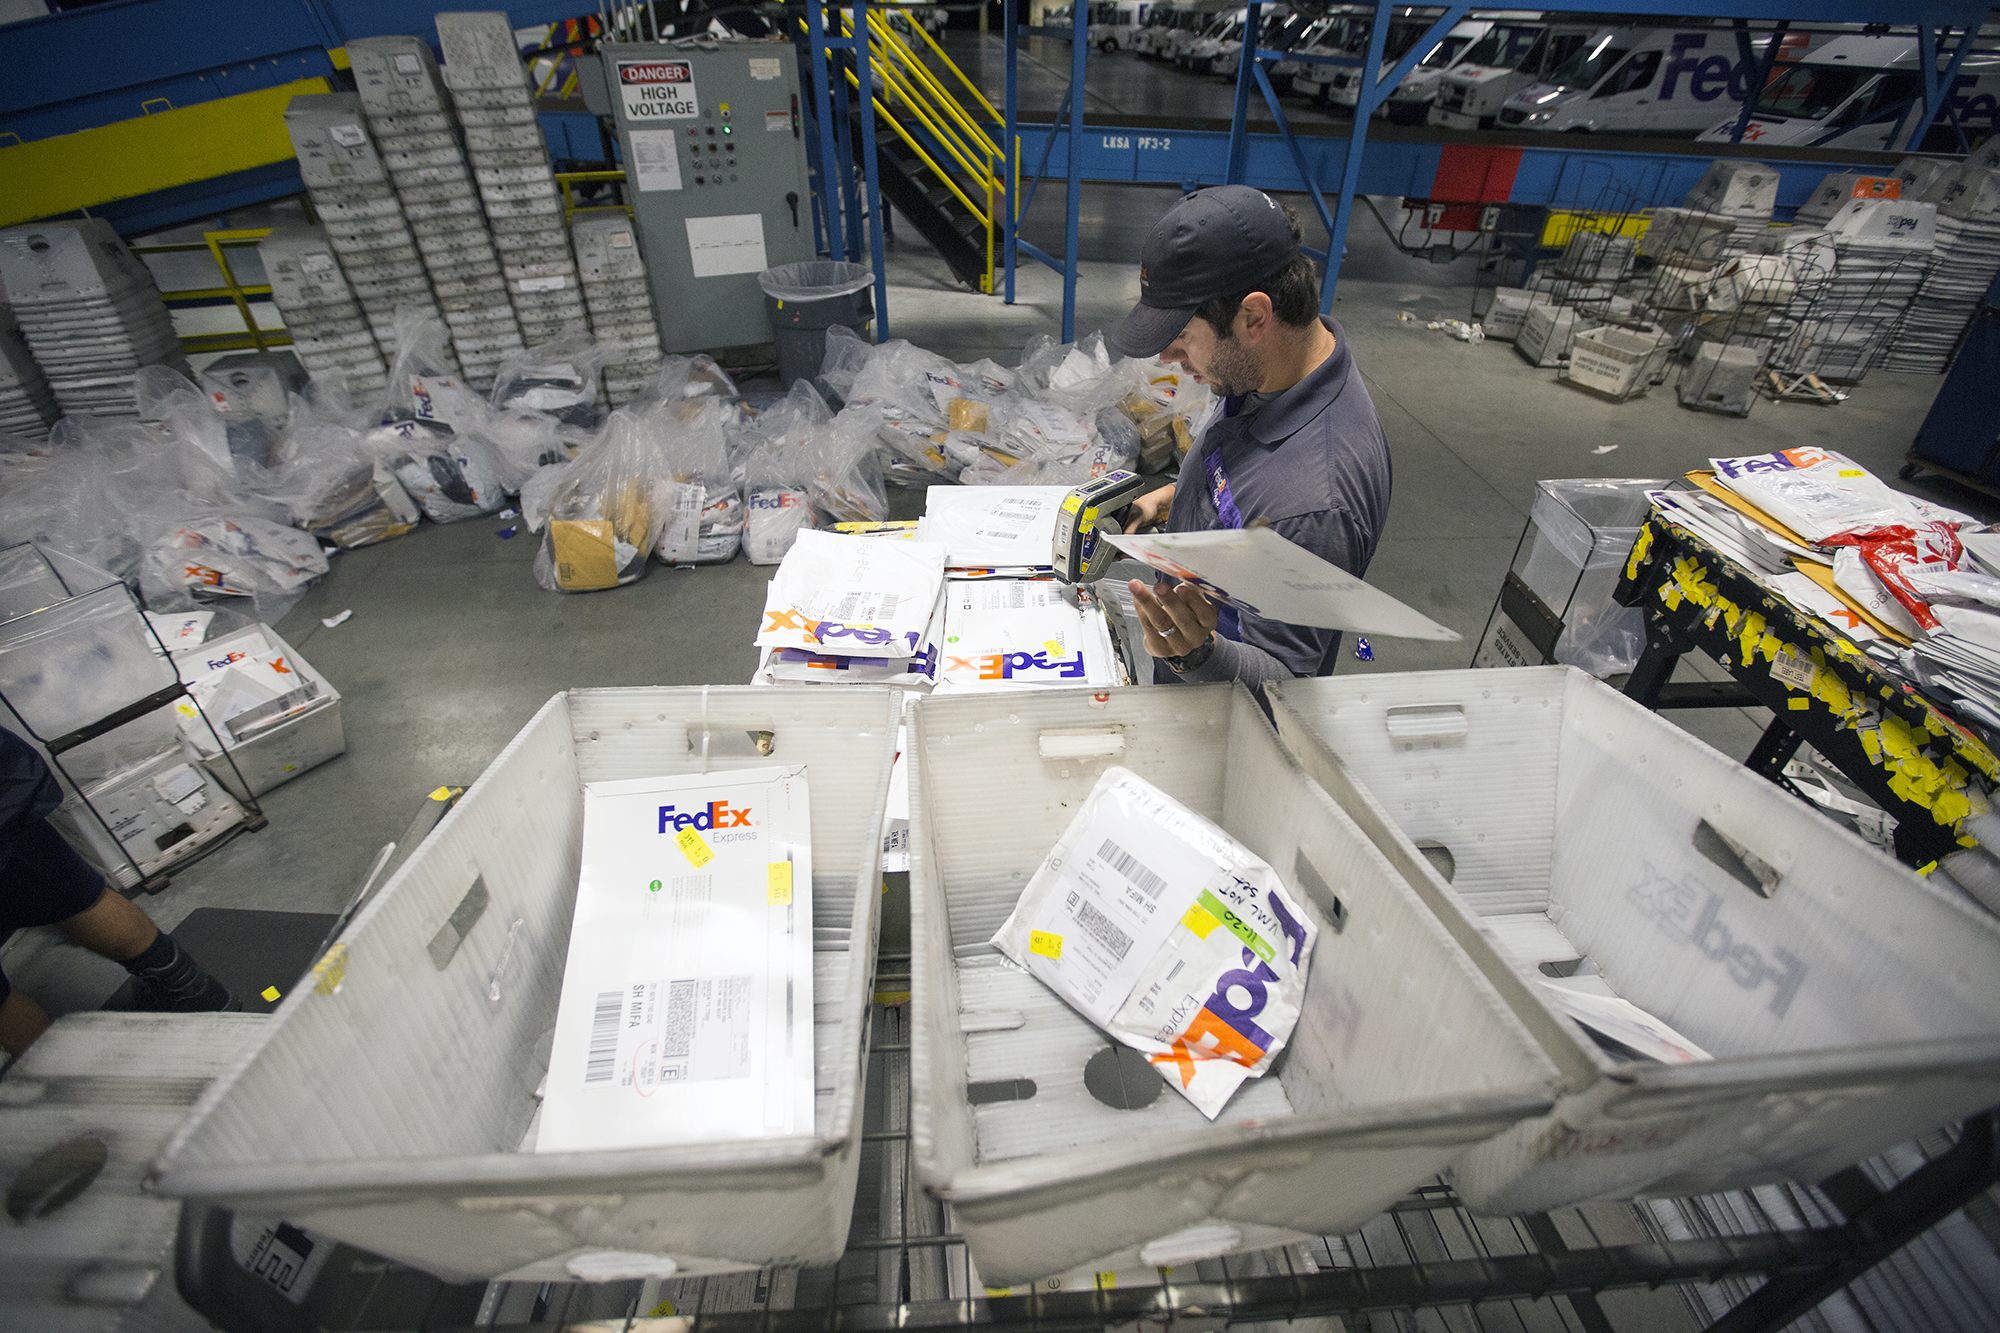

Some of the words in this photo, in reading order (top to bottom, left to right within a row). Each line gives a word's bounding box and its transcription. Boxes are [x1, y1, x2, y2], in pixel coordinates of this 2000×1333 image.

[628, 66, 684, 80] DANGER
[640, 86, 678, 100] HIGH
[628, 102, 695, 116] VOLTAGE
[1578, 355, 1600, 367] UNITED
[925, 371, 962, 388] FedEx
[1090, 444, 1112, 478] FedEx
[750, 493, 802, 510] FedEx
[1496, 626, 1521, 658] SERVICE
[207, 652, 246, 670] FedEx
[944, 650, 1086, 681] FedEx
[658, 800, 752, 834] FedEx
[712, 832, 758, 844] Express
[1046, 856, 1062, 870] ak
[1125, 885, 1146, 904] MIFA
[1218, 887, 1246, 905] NOT
[1144, 900, 1157, 914] SH
[632, 984, 644, 998] SH
[628, 1002, 643, 1028] MIFA
[664, 1070, 677, 1078] E
